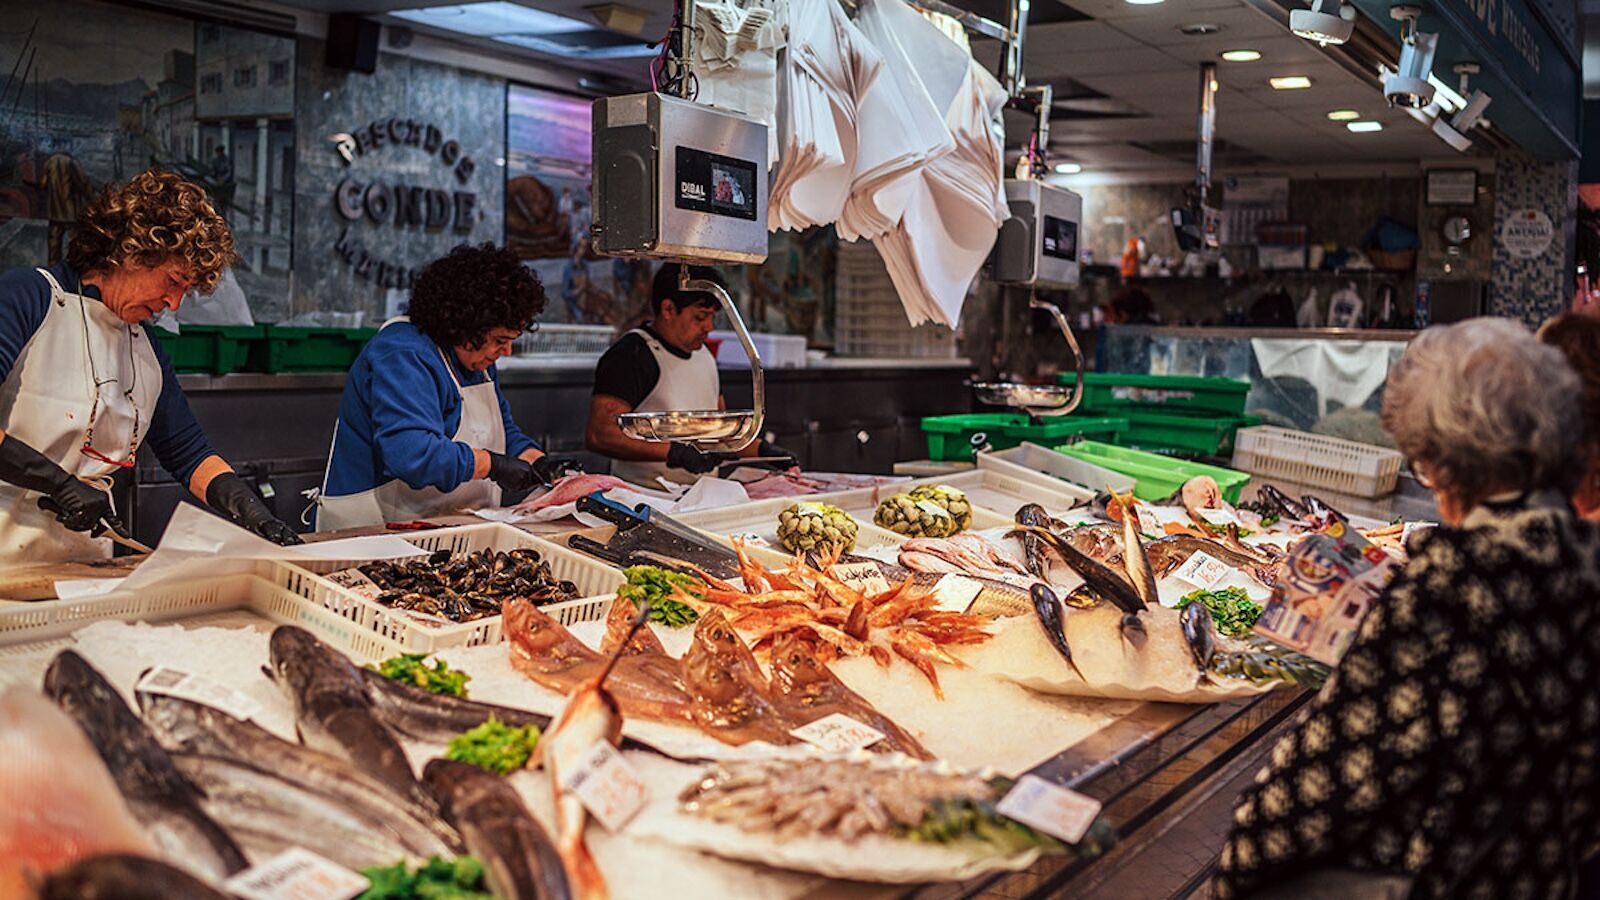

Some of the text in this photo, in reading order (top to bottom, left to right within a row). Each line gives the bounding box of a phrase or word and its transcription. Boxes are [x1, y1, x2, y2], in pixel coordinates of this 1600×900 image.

[330, 117, 475, 185] PESCADOS
[334, 179, 476, 232] CONDE
[681, 181, 706, 195] DIBAL
